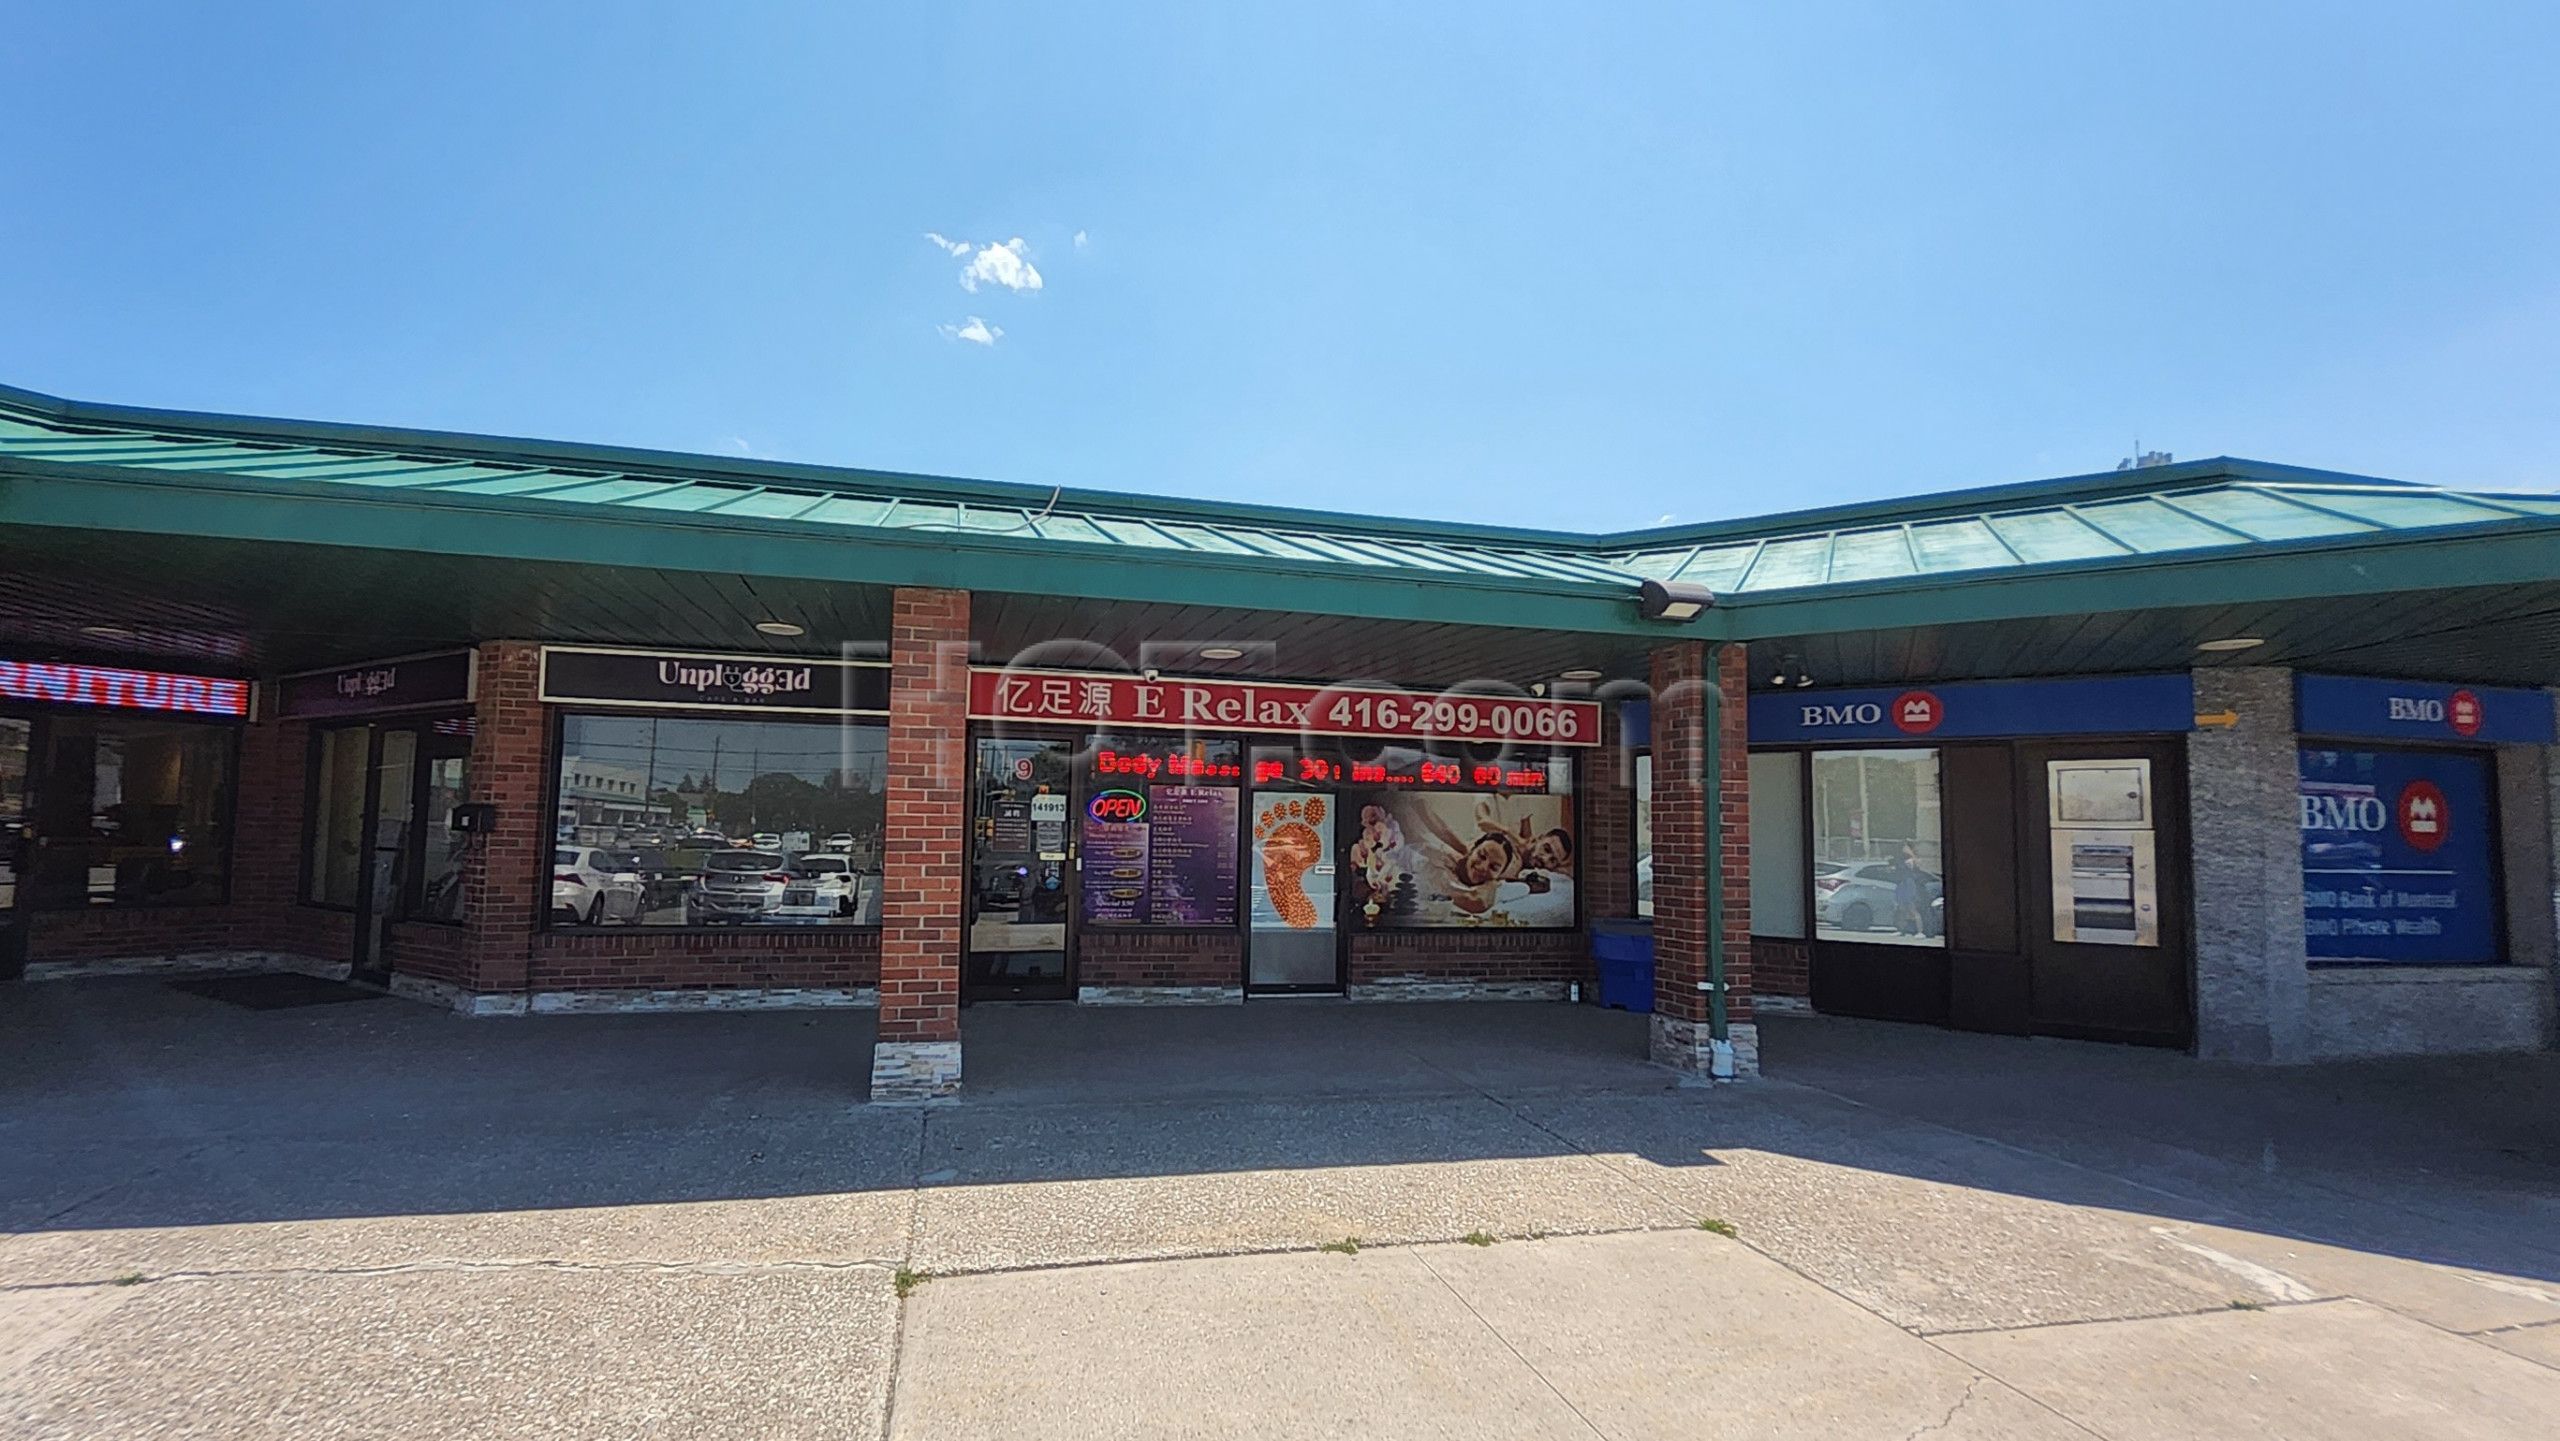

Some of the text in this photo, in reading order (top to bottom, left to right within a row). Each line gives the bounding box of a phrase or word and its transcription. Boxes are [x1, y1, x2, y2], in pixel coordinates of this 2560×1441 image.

[997, 676, 1579, 738] 亿足源 E Relax 416-299-0066
[1800, 703, 1882, 726] BMO
[2388, 697, 2444, 722] BMO
[1014, 757, 1033, 780] 9
[1032, 802, 1066, 813] 141913
[1091, 798, 1142, 818] OPEN
[2298, 794, 2387, 832] BMO
